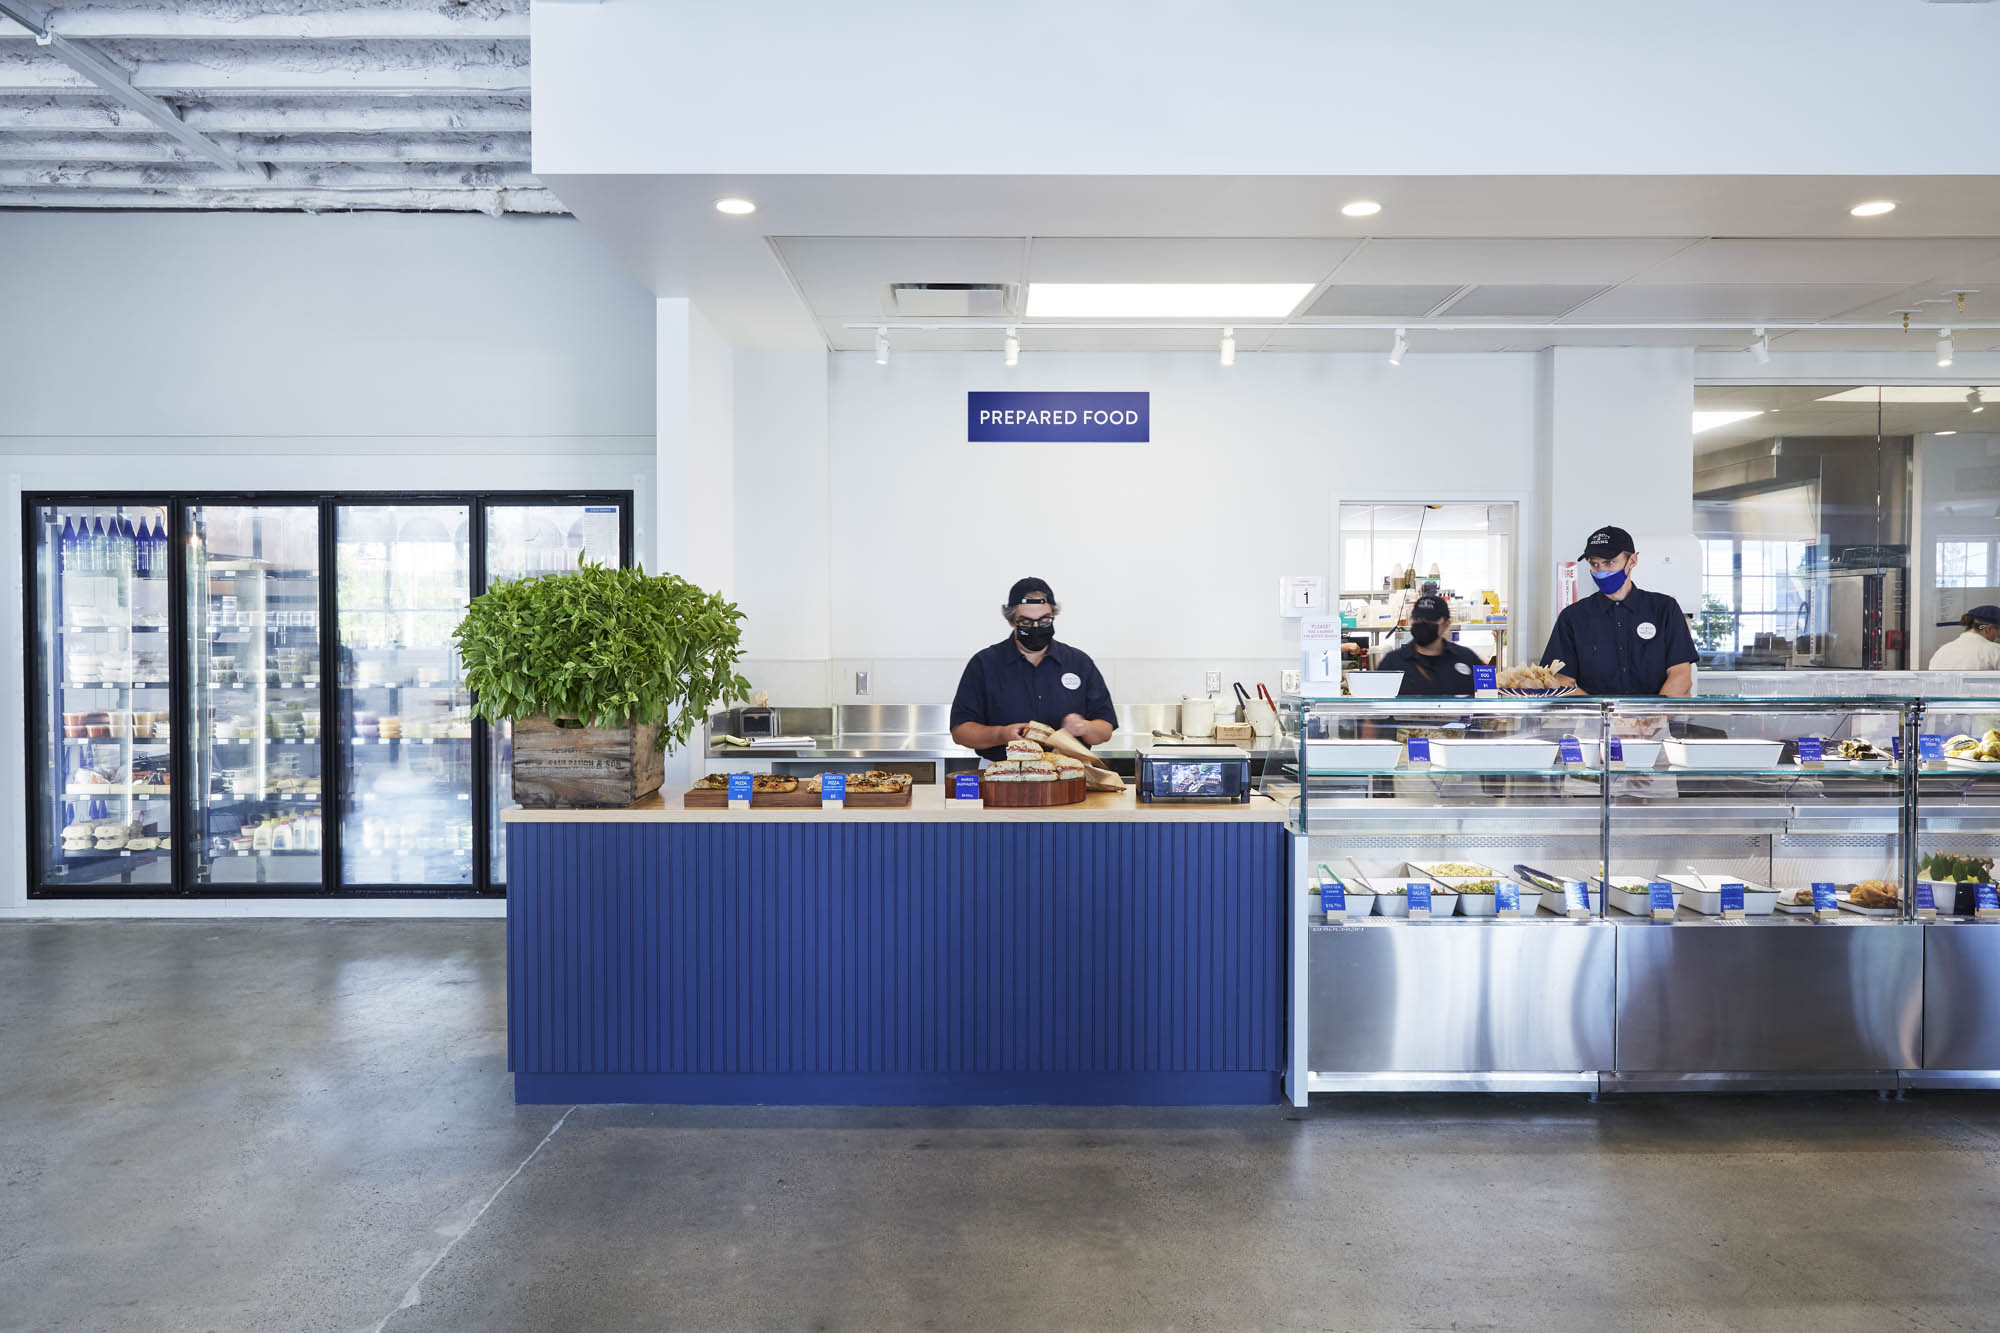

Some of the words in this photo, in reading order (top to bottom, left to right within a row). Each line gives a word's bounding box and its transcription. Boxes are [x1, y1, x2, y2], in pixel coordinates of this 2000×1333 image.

[980, 410, 1077, 425] PREPARED
[1083, 410, 1139, 425] FOOD
[1303, 591, 1309, 605] 1
[1321, 656, 1329, 677] 1
